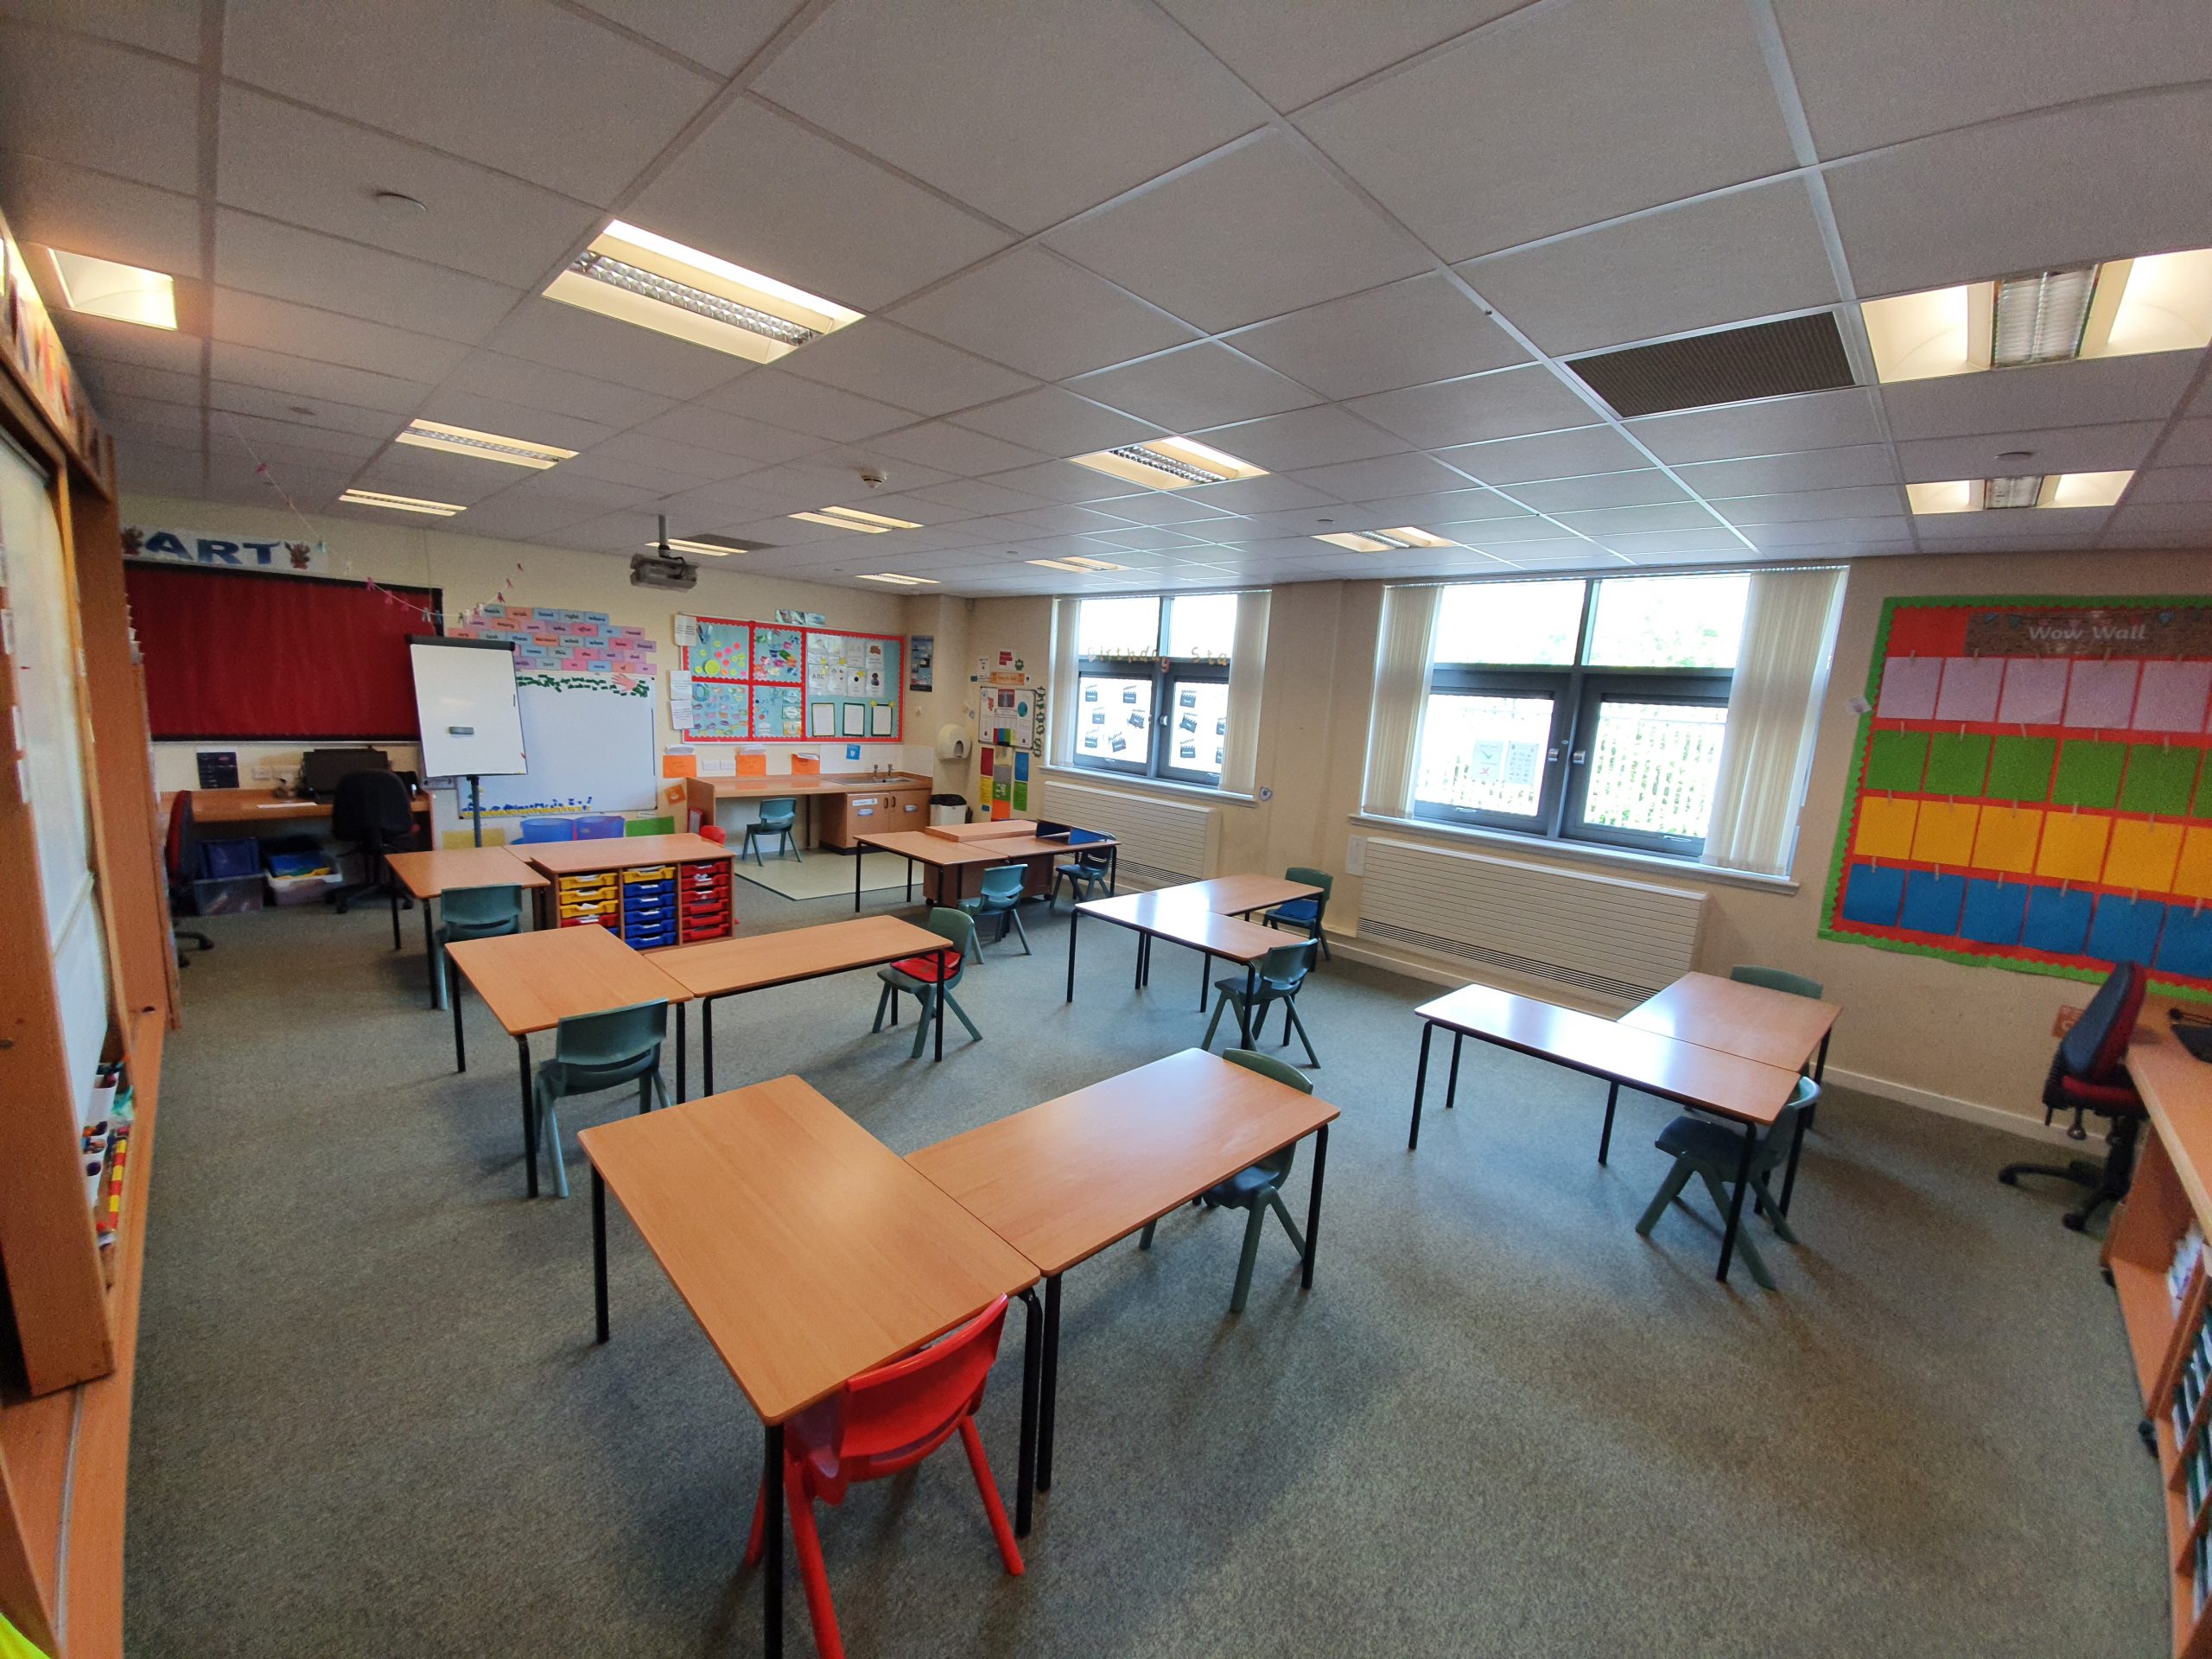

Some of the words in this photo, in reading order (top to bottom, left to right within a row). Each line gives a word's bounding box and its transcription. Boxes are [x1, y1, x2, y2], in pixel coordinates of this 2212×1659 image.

[145, 531, 281, 564] ART
[2029, 626, 2083, 639] Wow
[2092, 624, 2145, 639] Wall
